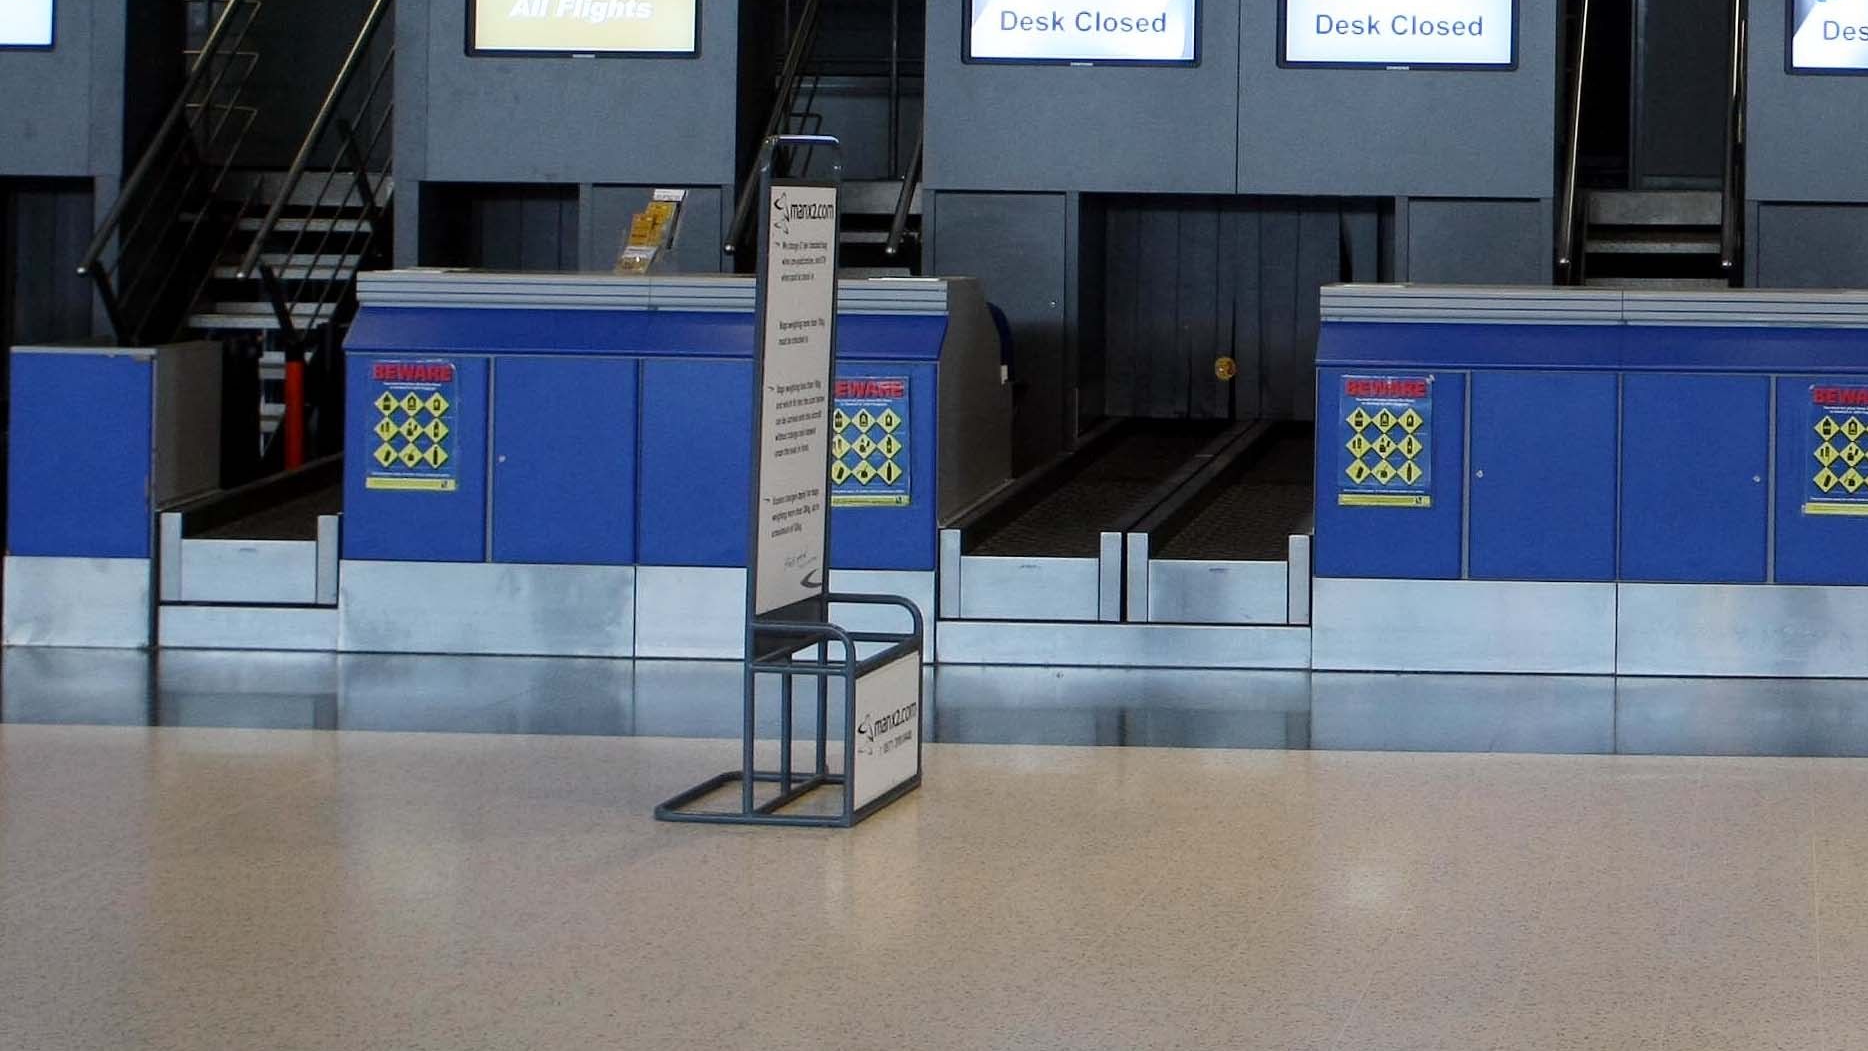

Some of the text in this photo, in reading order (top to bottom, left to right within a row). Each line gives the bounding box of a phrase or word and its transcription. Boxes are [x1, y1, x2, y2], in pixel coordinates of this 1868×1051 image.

[1000, 11, 1167, 34] Desk Closed
[1316, 14, 1484, 37] Desk Closed
[374, 363, 454, 382] BEWARE
[834, 379, 904, 399] EWARE
[1345, 378, 1427, 398] BEWARE
